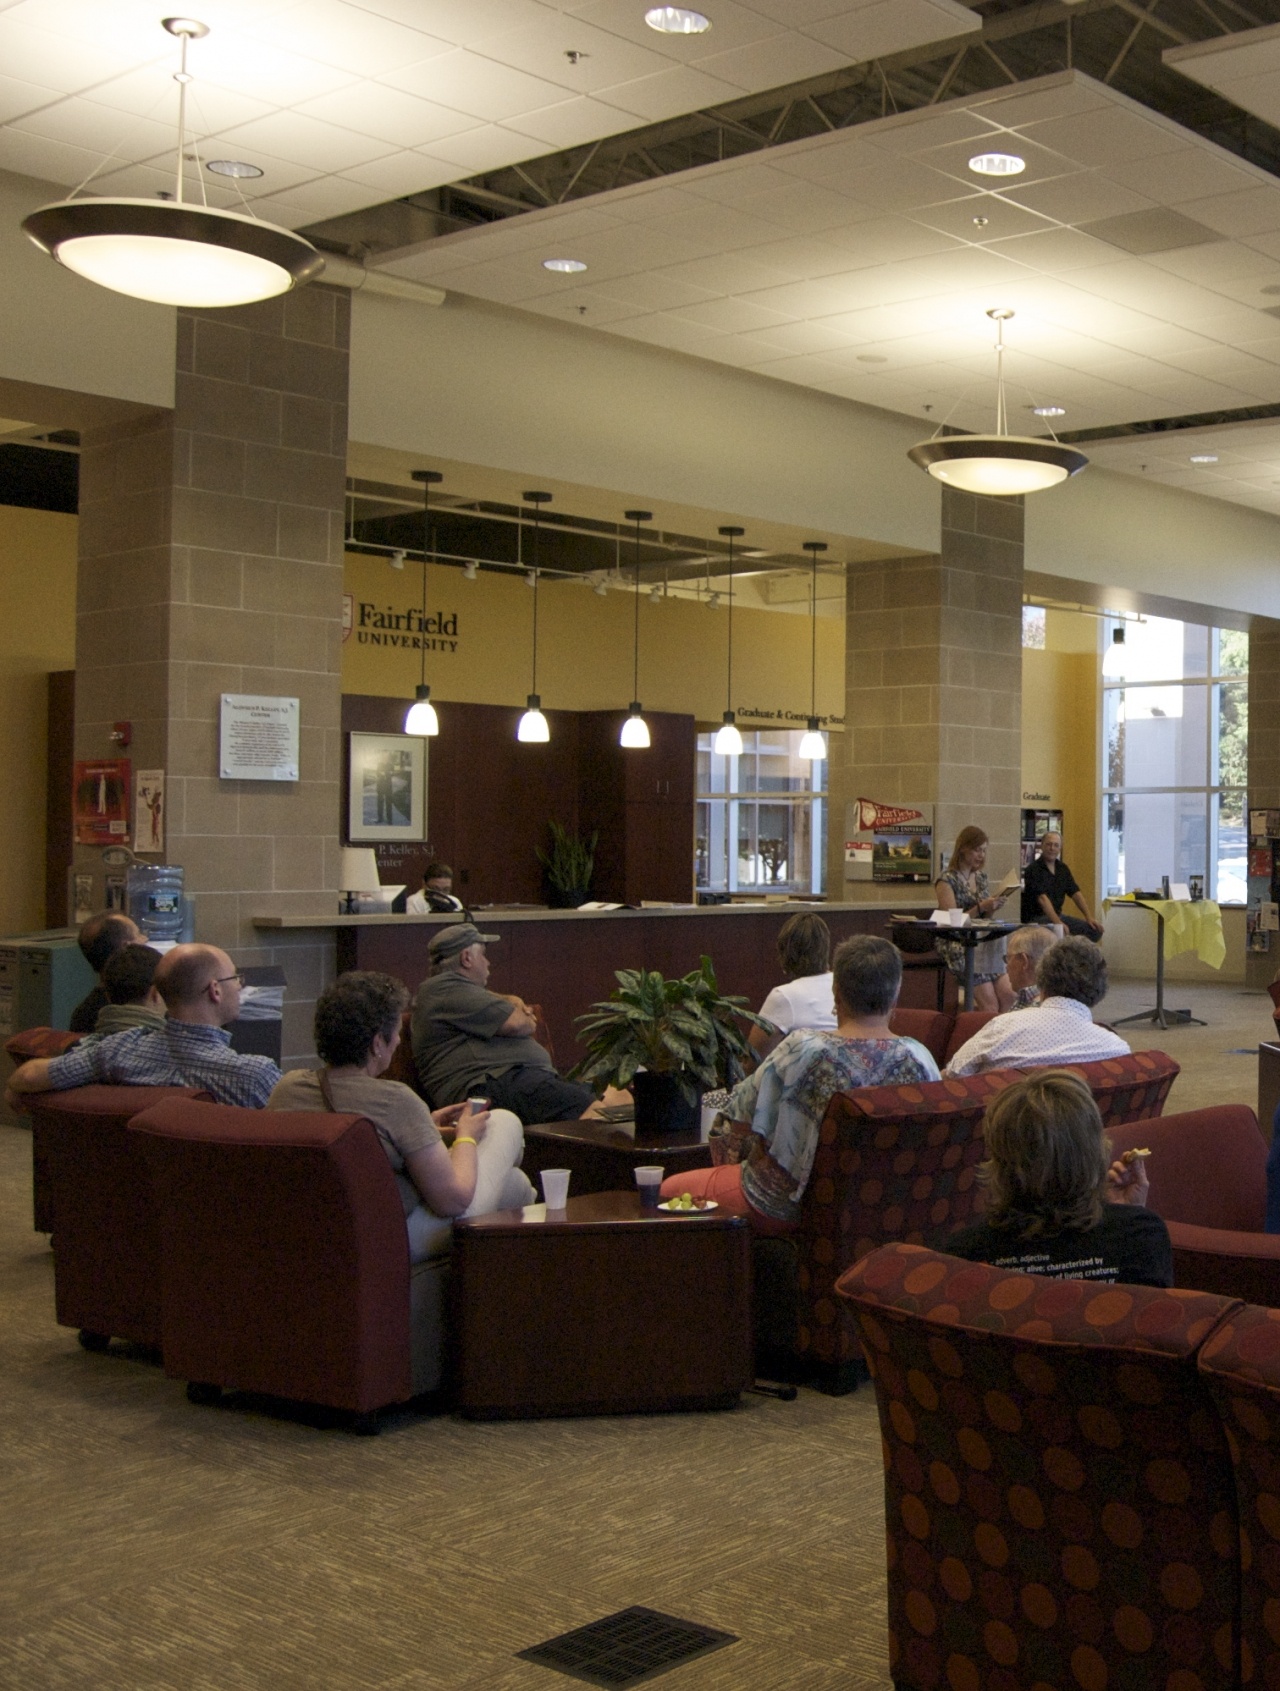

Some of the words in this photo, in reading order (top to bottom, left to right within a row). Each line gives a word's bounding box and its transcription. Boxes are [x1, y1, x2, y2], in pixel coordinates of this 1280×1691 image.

[358, 602, 459, 636] Fairfield
[358, 631, 459, 652] UNIVERSITY
[737, 707, 775, 719] Graduate
[776, 710, 783, 719] &
[785, 711, 828, 726] Contining
[1023, 792, 1051, 801] Graduate
[377, 859, 403, 867] enter
[1047, 1258, 1094, 1271] characterized
[1094, 1257, 1104, 1266] by
[1064, 1271, 1084, 1280] living
